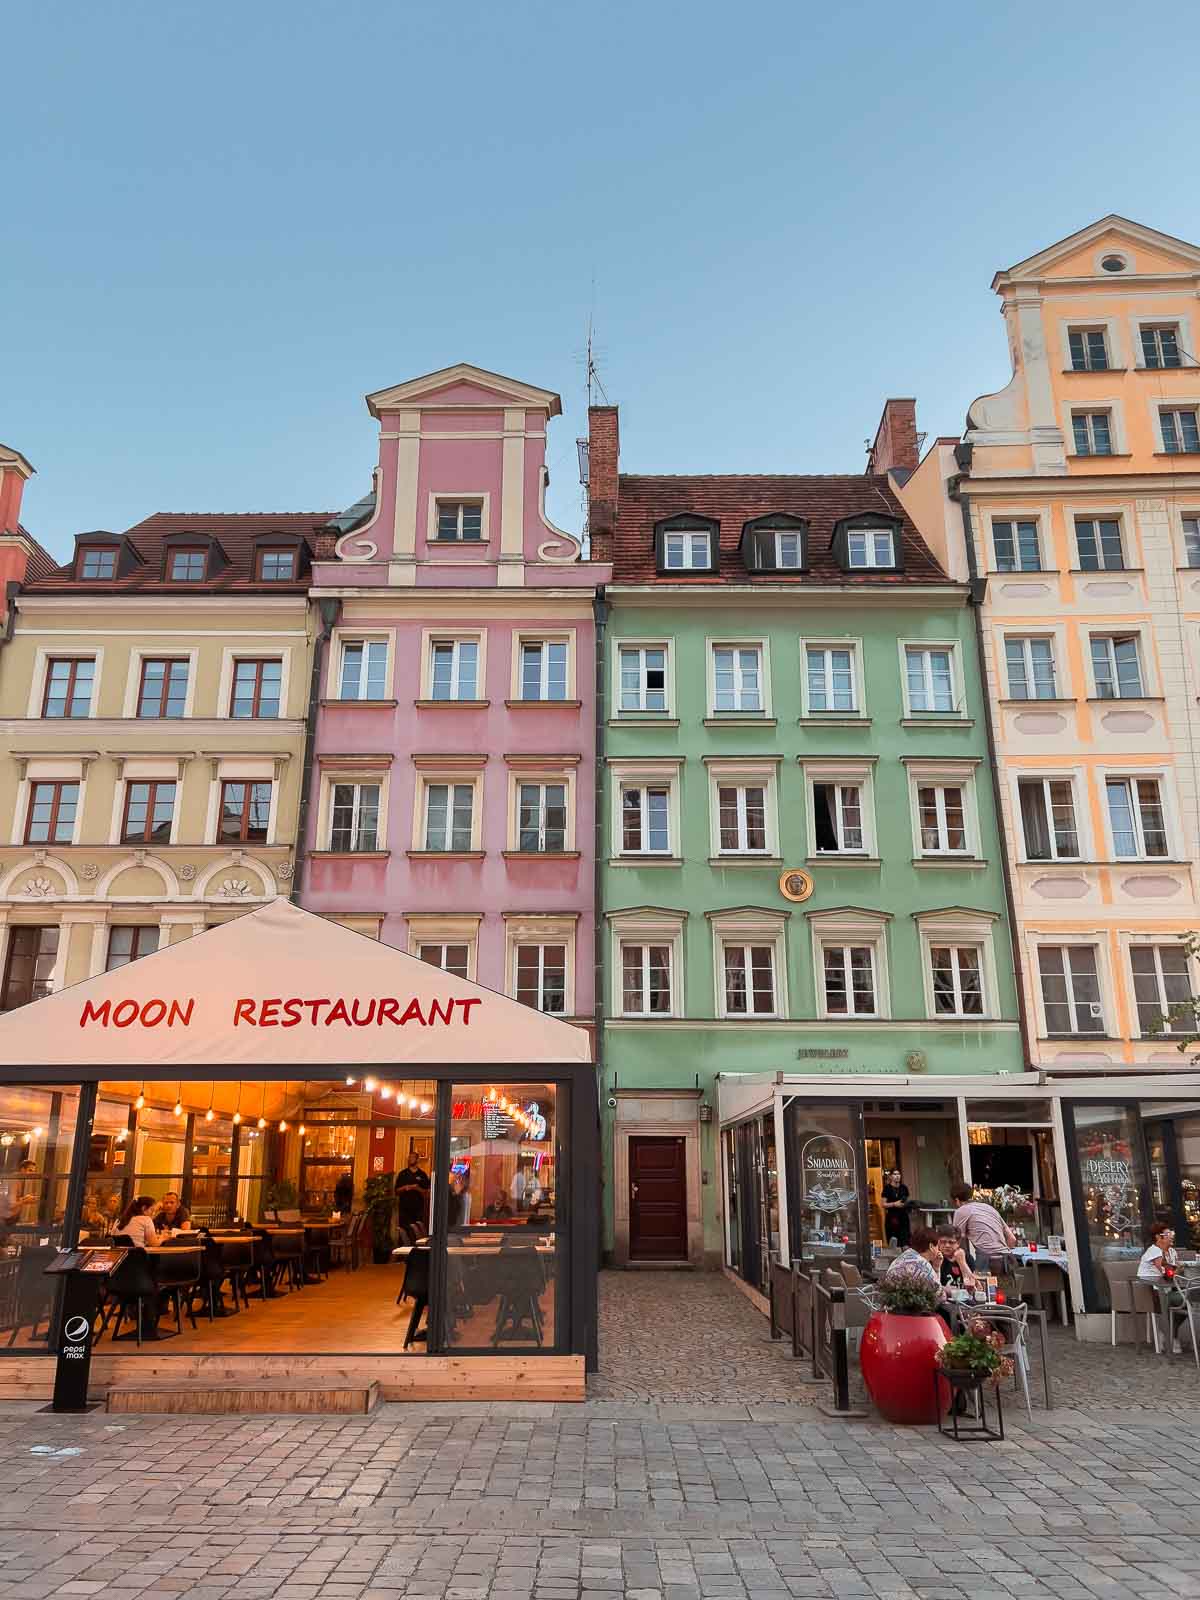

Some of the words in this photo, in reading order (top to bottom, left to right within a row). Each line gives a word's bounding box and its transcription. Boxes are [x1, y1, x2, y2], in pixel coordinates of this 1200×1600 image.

[80, 998, 194, 1028] MOON
[233, 997, 483, 1027] RESTAURANT
[63, 1345, 86, 1354] pepsi
